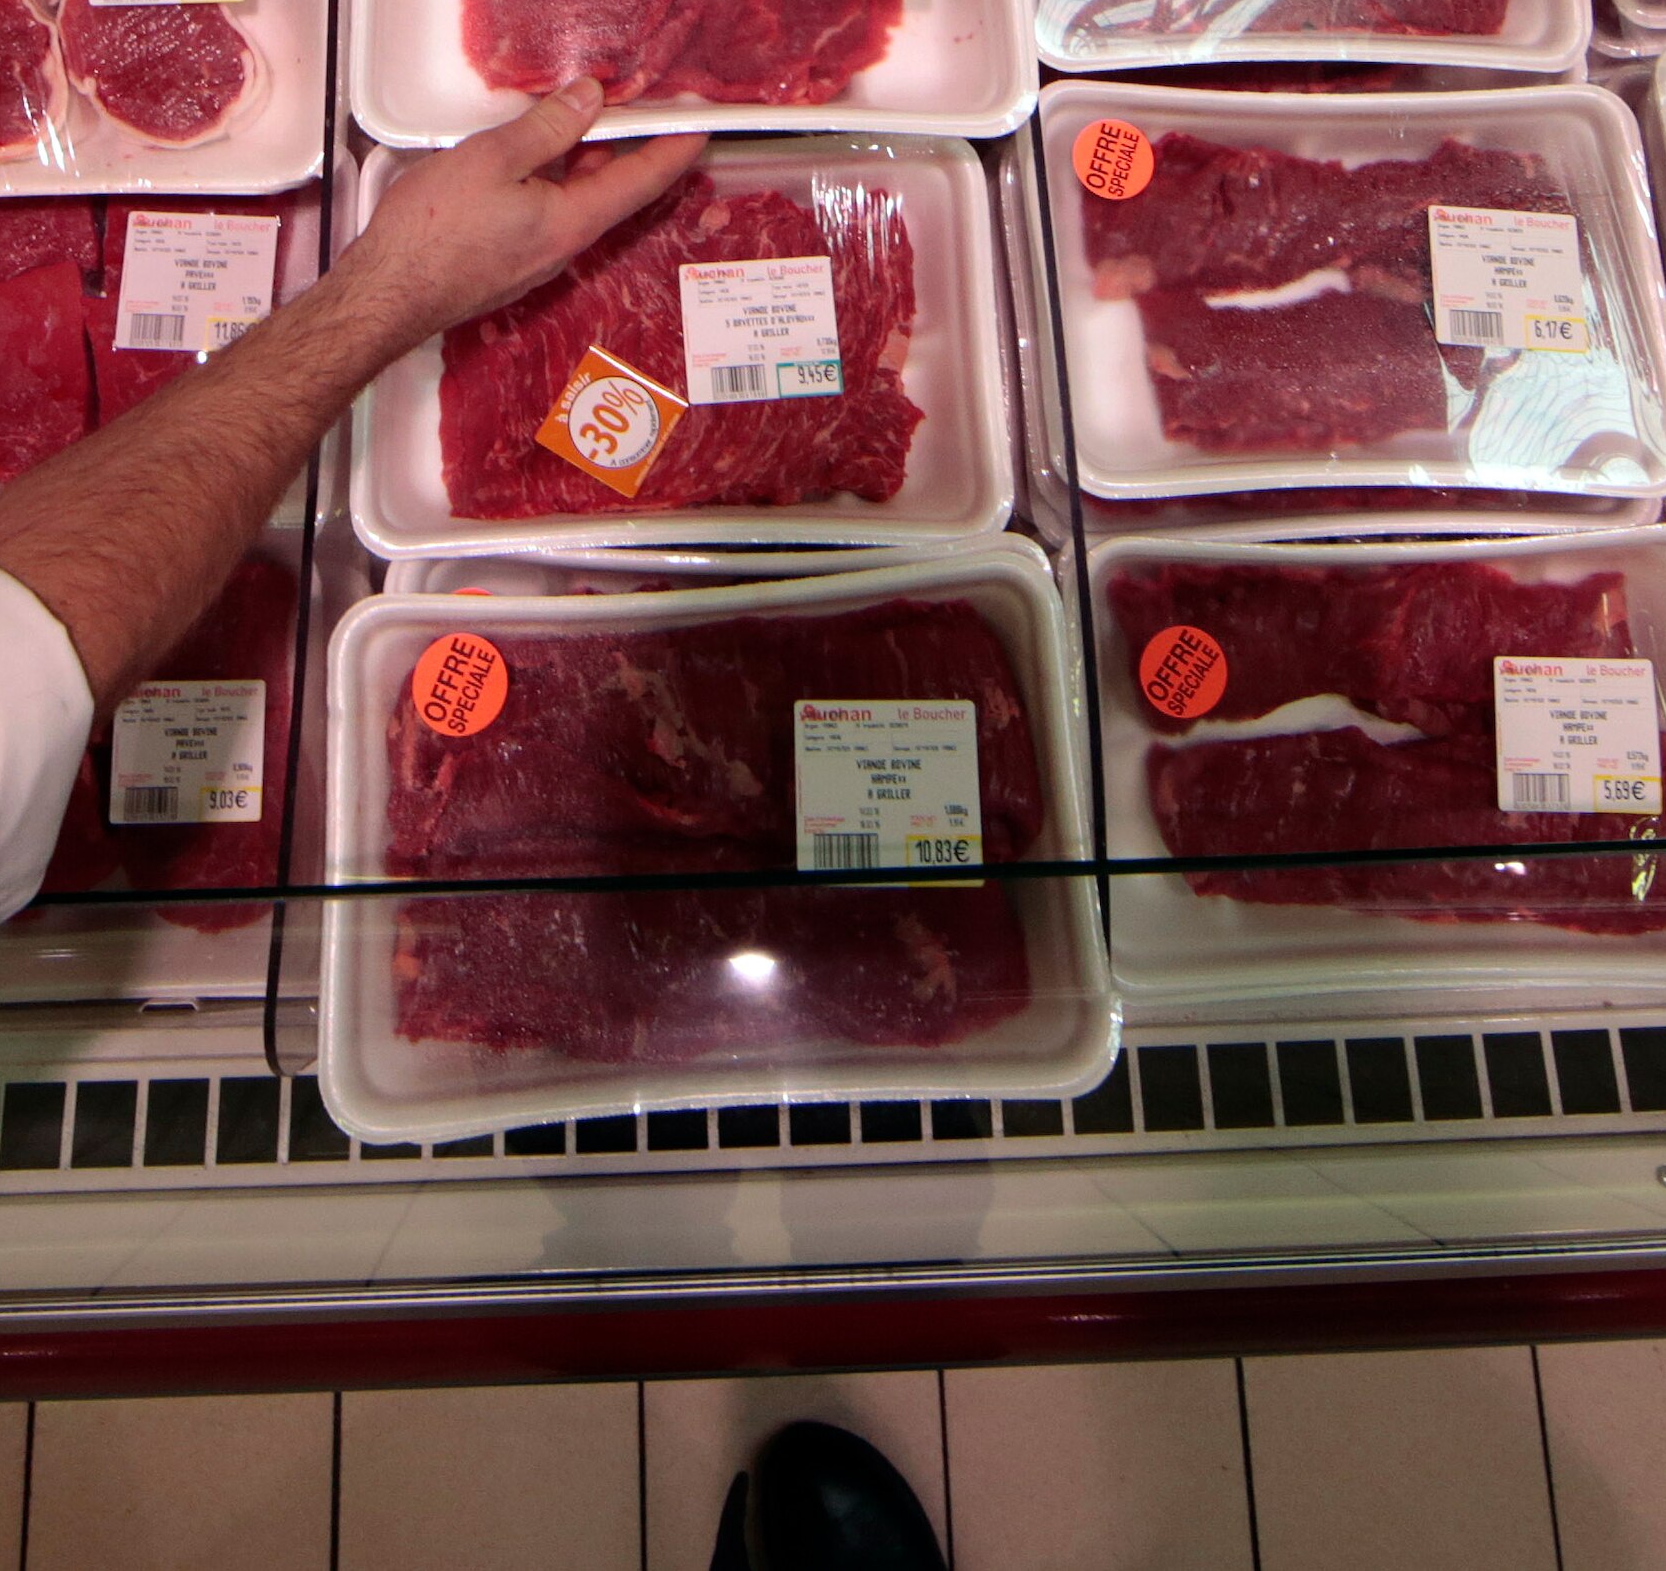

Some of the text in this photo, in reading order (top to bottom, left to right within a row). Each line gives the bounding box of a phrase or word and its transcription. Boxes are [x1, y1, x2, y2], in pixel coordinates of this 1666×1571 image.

[1086, 122, 1122, 190] OFFRE
[1108, 133, 1140, 197] SPECIALE
[1534, 318, 1572, 340] 6,17€
[797, 364, 837, 385] 9,45€
[579, 377, 644, 461] -30%
[1147, 628, 1203, 702] OFFRE
[1167, 641, 1220, 716] SPECIALE
[424, 637, 478, 722] OFFRE
[448, 648, 497, 734] SPECIALE
[800, 703, 966, 722] Auchan le Boucher
[856, 758, 922, 770] VIANDE BOVINE
[209, 790, 248, 810] 9,03€
[878, 788, 911, 799] GRILLER
[1603, 780, 1645, 801] 5,69€
[915, 838, 970, 866] 10,83€
